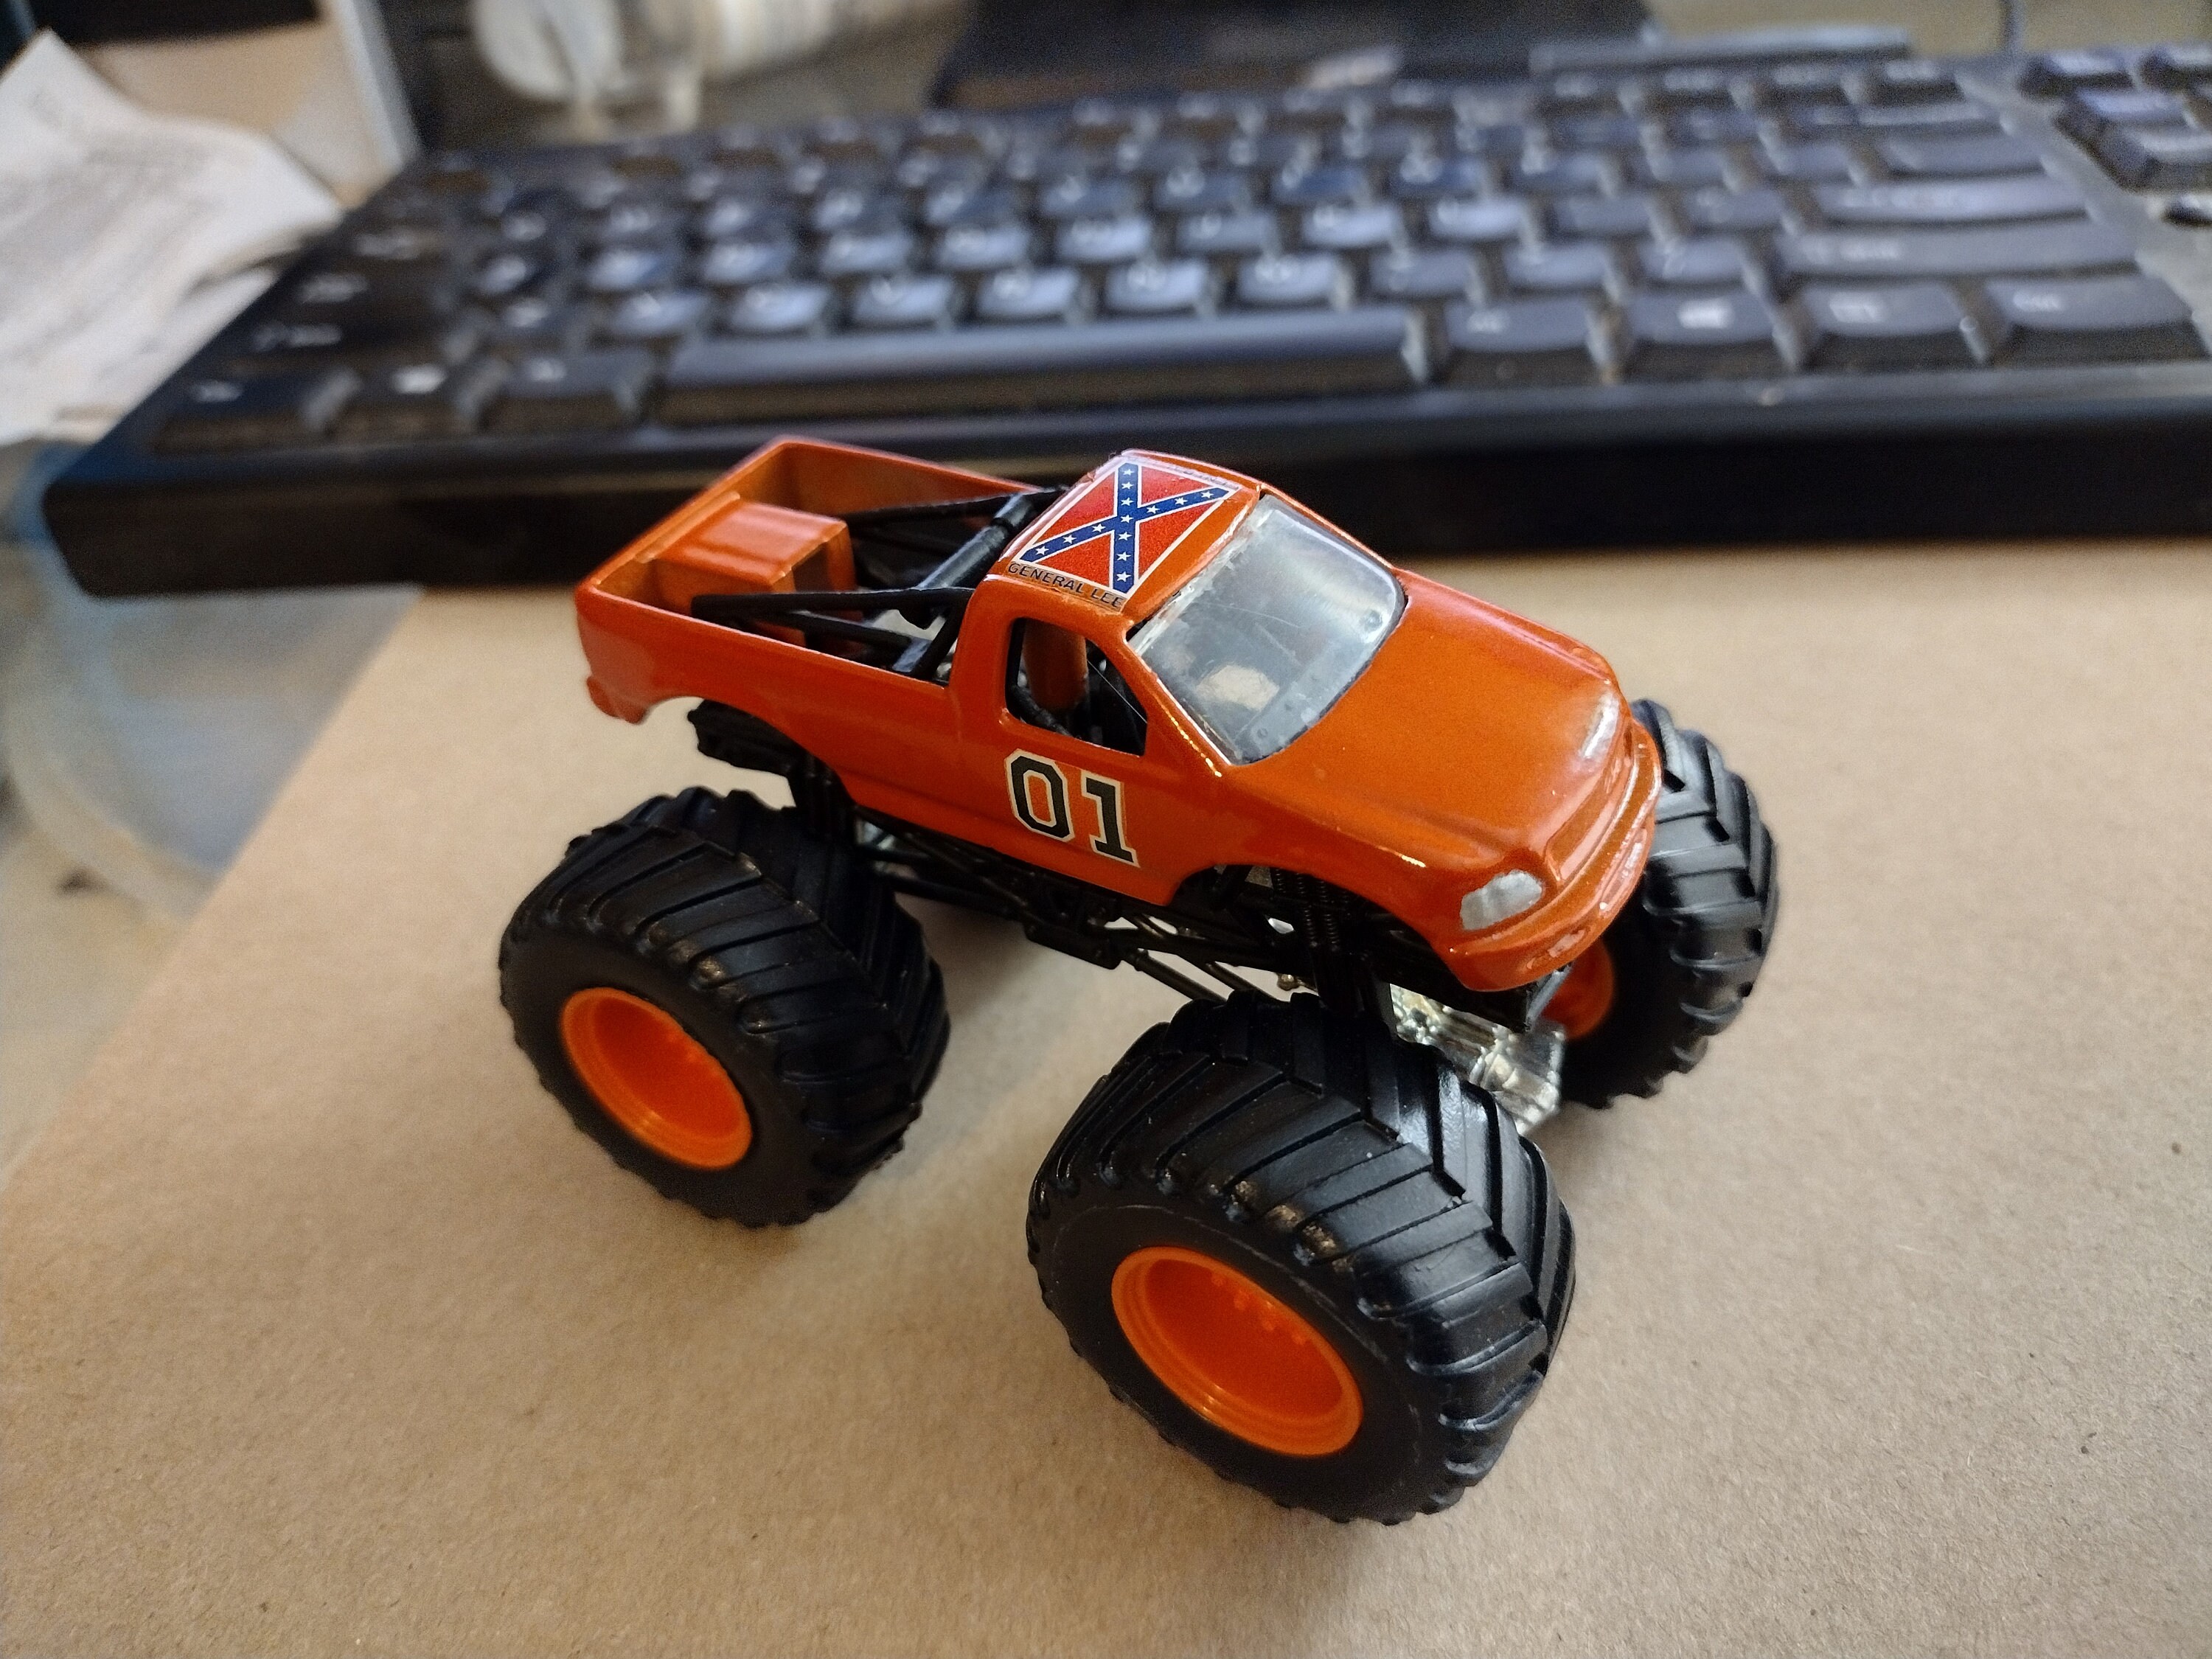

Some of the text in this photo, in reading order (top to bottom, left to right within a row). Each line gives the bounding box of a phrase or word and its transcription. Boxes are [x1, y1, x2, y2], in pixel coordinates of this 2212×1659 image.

[1008, 562, 1124, 608] GENERAL LEE
[1005, 749, 1139, 867] 01
